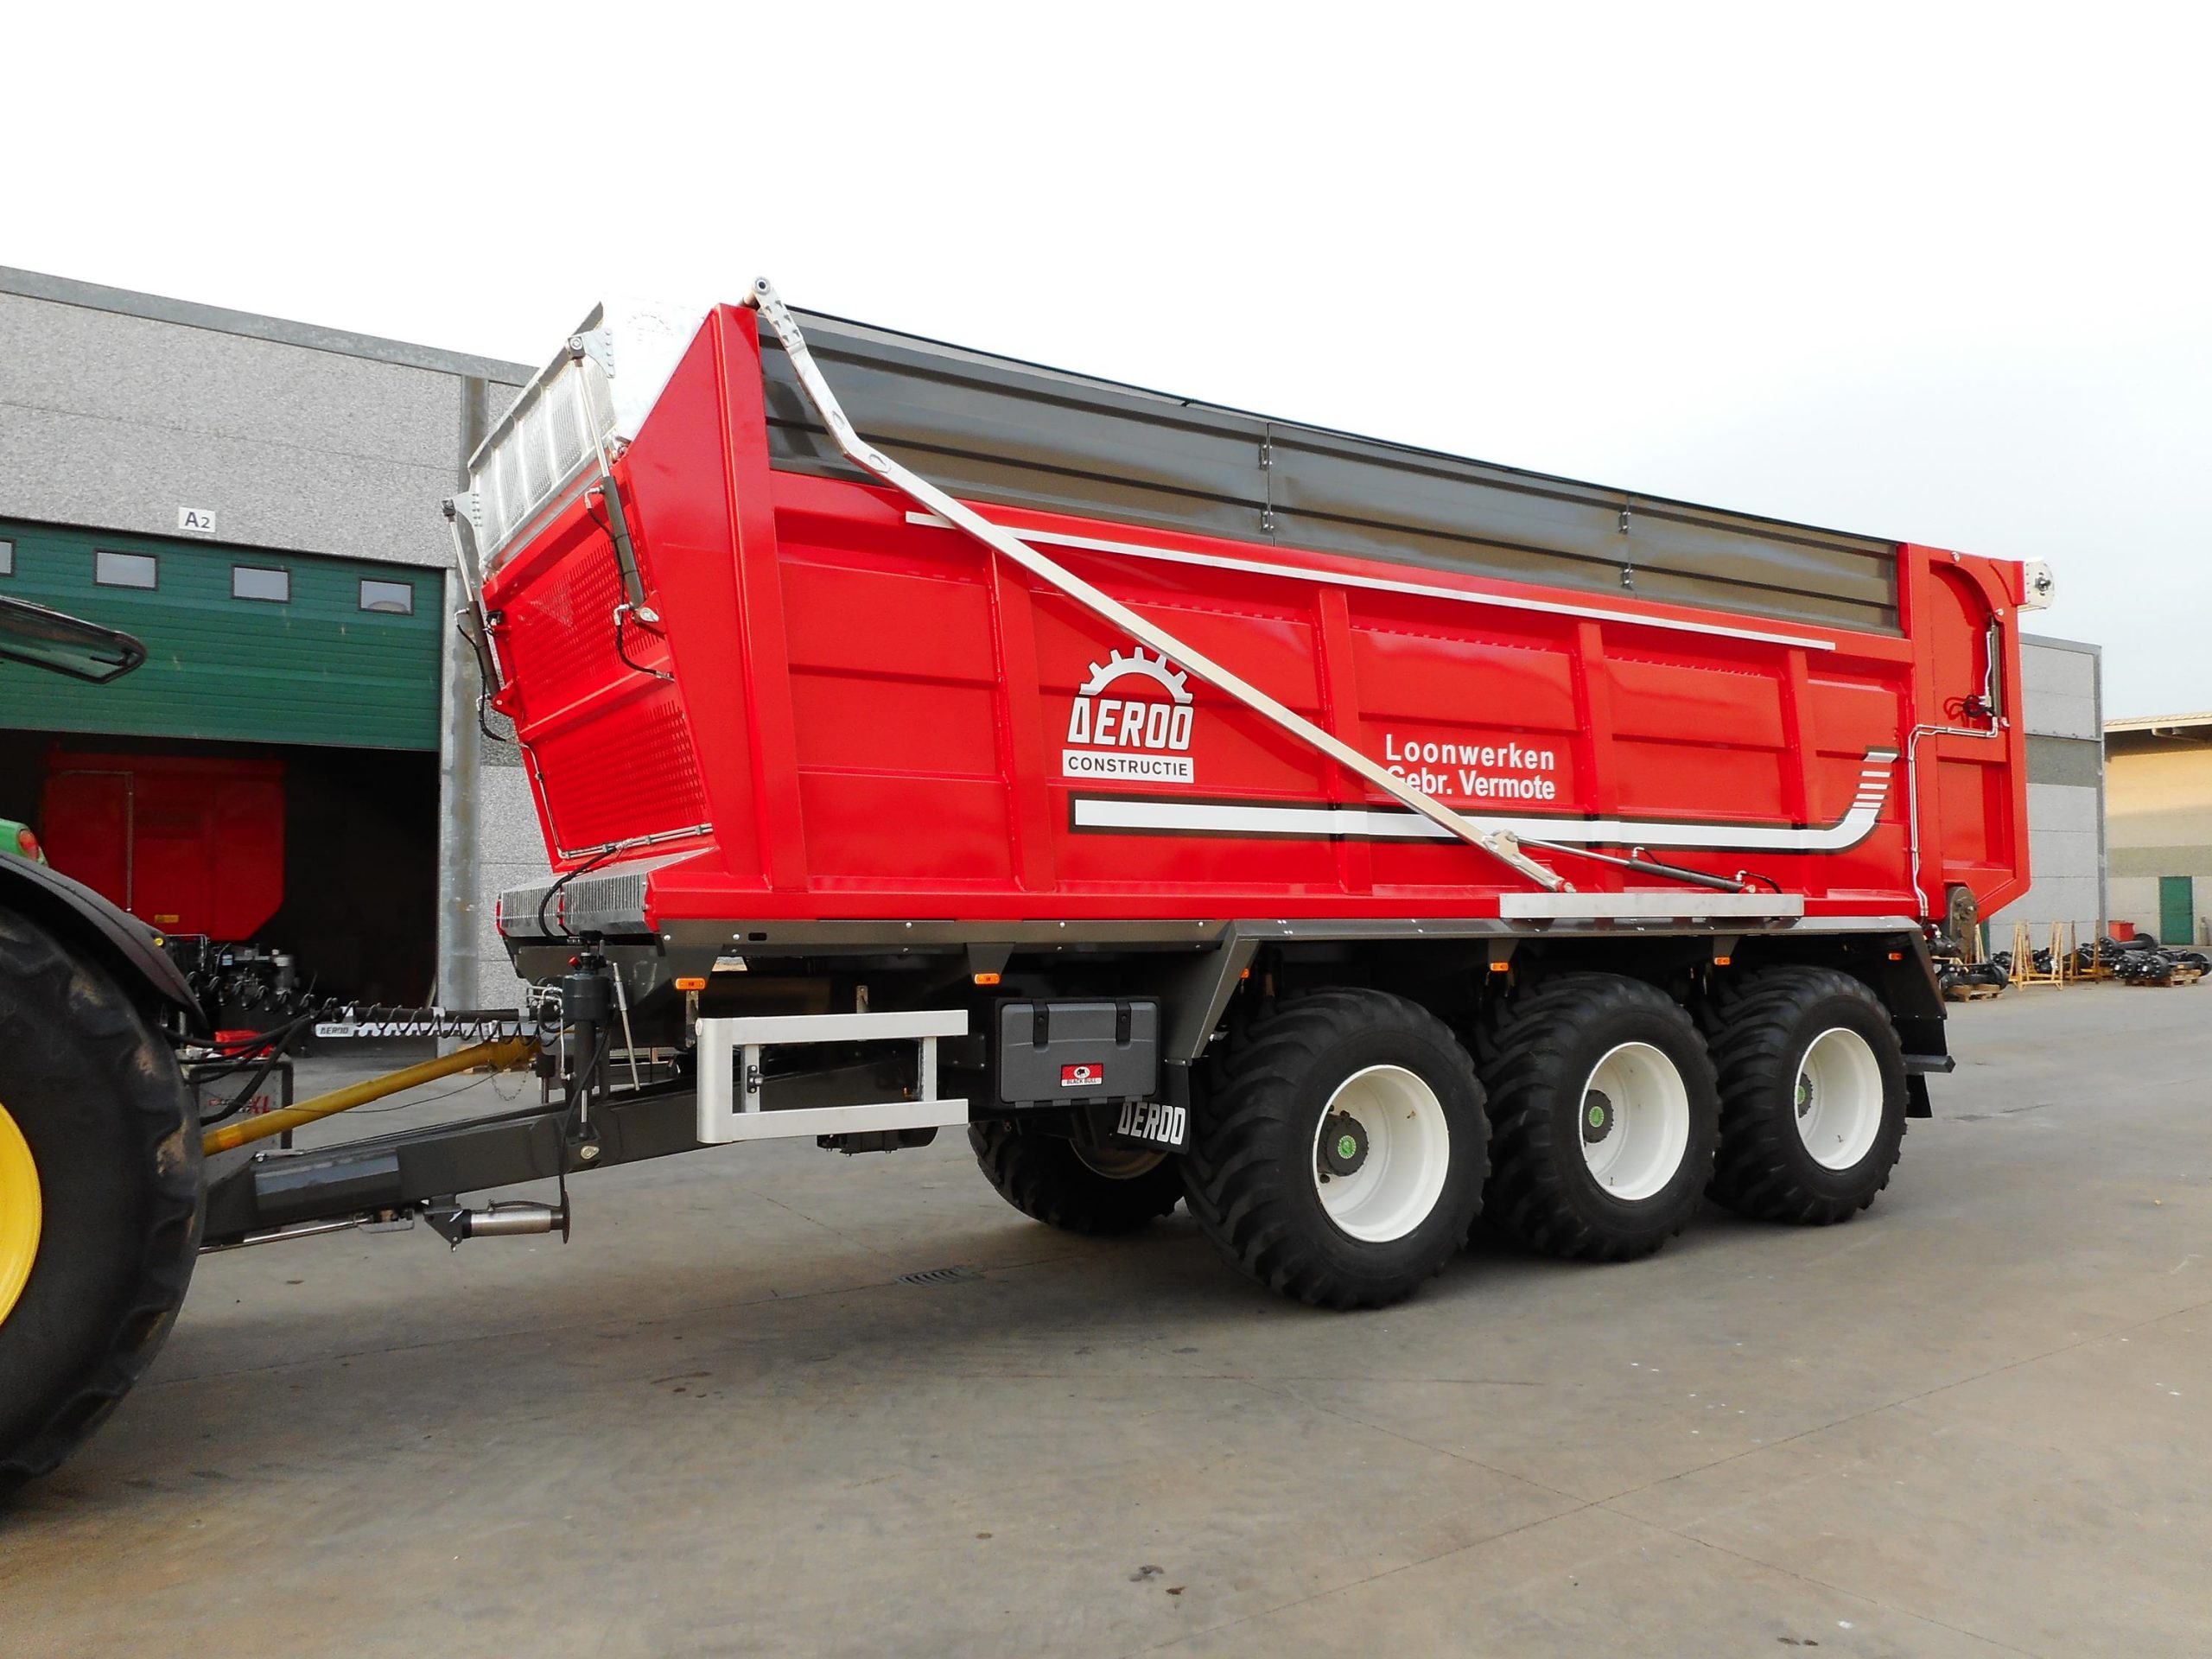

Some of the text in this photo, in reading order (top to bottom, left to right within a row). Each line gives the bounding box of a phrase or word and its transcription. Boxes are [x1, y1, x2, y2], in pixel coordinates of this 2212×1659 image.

[184, 511, 211, 529] A2
[1067, 696, 1194, 751] AEROO
[1068, 756, 1188, 776] CONSTRUCTIE
[1385, 734, 1555, 771] Loonwerken
[1459, 769, 1555, 800] Vermote
